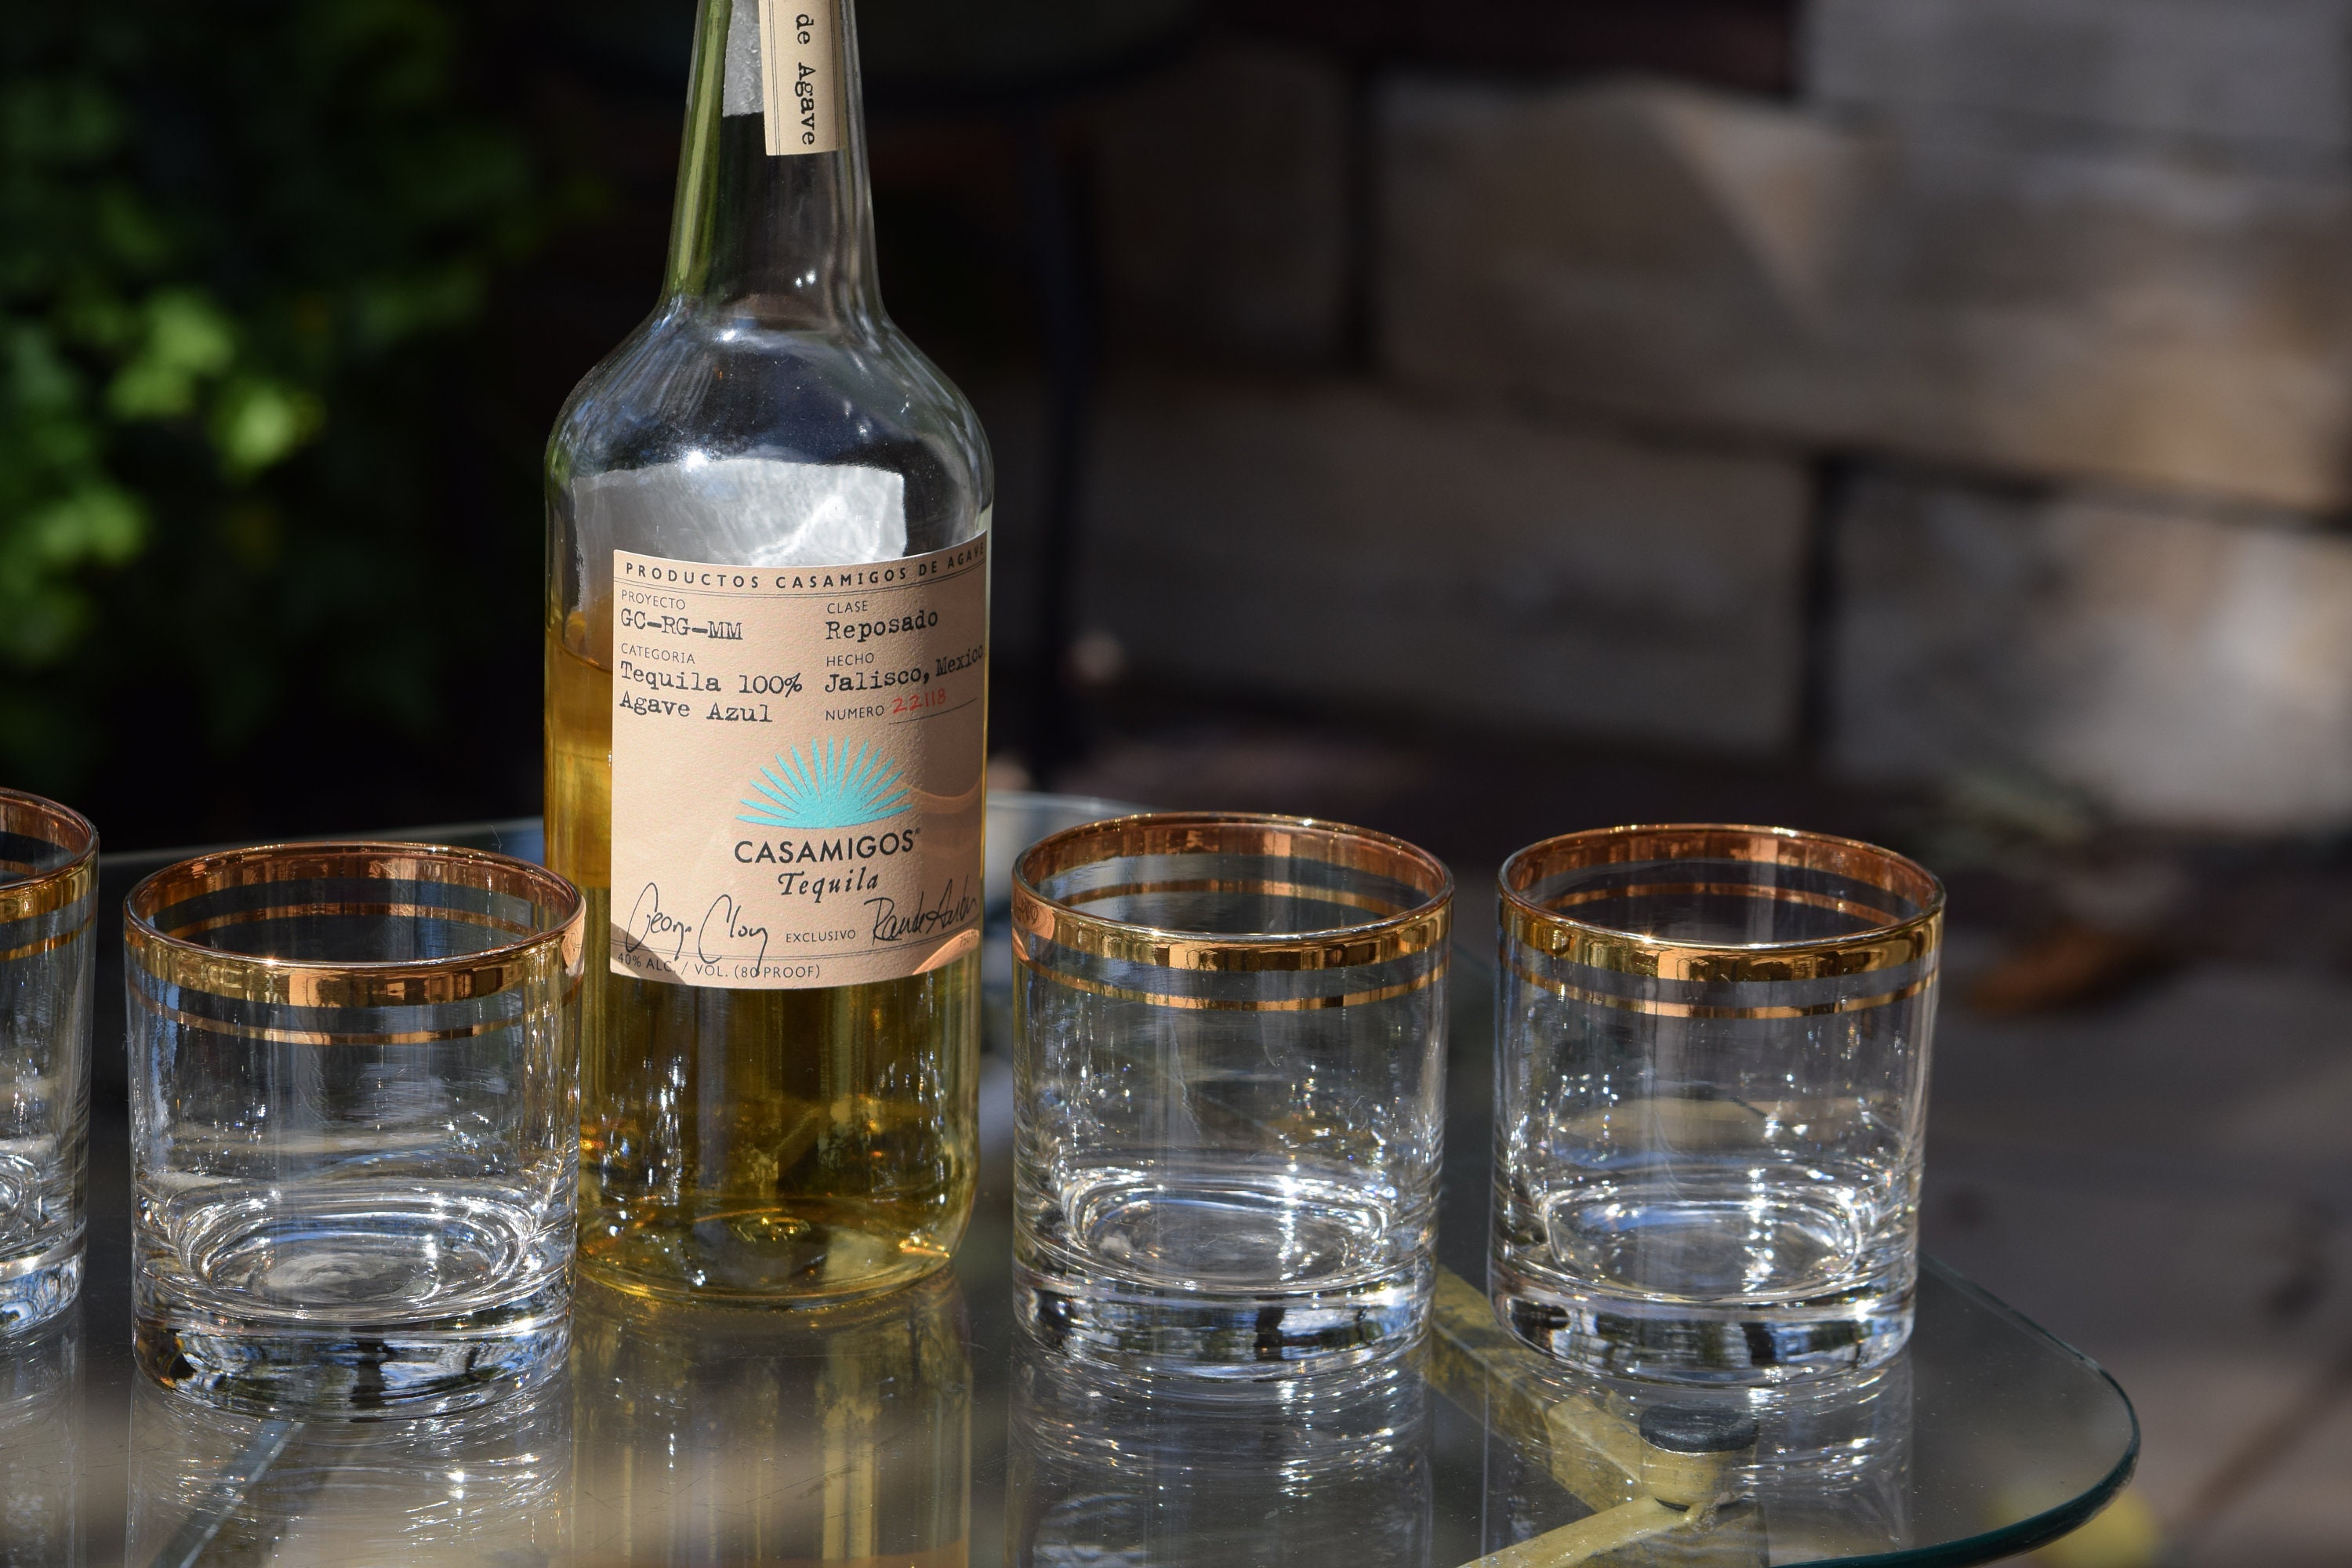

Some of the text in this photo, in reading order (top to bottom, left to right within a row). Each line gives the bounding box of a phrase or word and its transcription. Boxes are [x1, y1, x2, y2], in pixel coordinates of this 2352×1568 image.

[795, 13, 816, 145] de Agave
[626, 542, 984, 589] PRODUCTOS CASAMIGOS DE AGAVE
[621, 590, 686, 611] PROYECTO
[826, 600, 869, 614] CLASE
[825, 609, 938, 643] Reposado
[620, 642, 696, 665] CATEGORIA
[825, 644, 983, 693] Jalisco, Mexico
[826, 652, 875, 667] HECHO
[620, 661, 803, 698] Tequila 100%
[619, 690, 773, 723] Agave Azul
[826, 688, 947, 721] NUMERO 22118
[734, 828, 915, 864] CASAMIGOS
[778, 866, 880, 903] Tequila
[786, 928, 856, 943] EXCLUSIVO
[618, 953, 641, 967] 40%
[646, 959, 677, 973] ALC.
[695, 963, 728, 978] VOL.
[734, 964, 760, 979] (80
[764, 964, 821, 979] PROOF)
